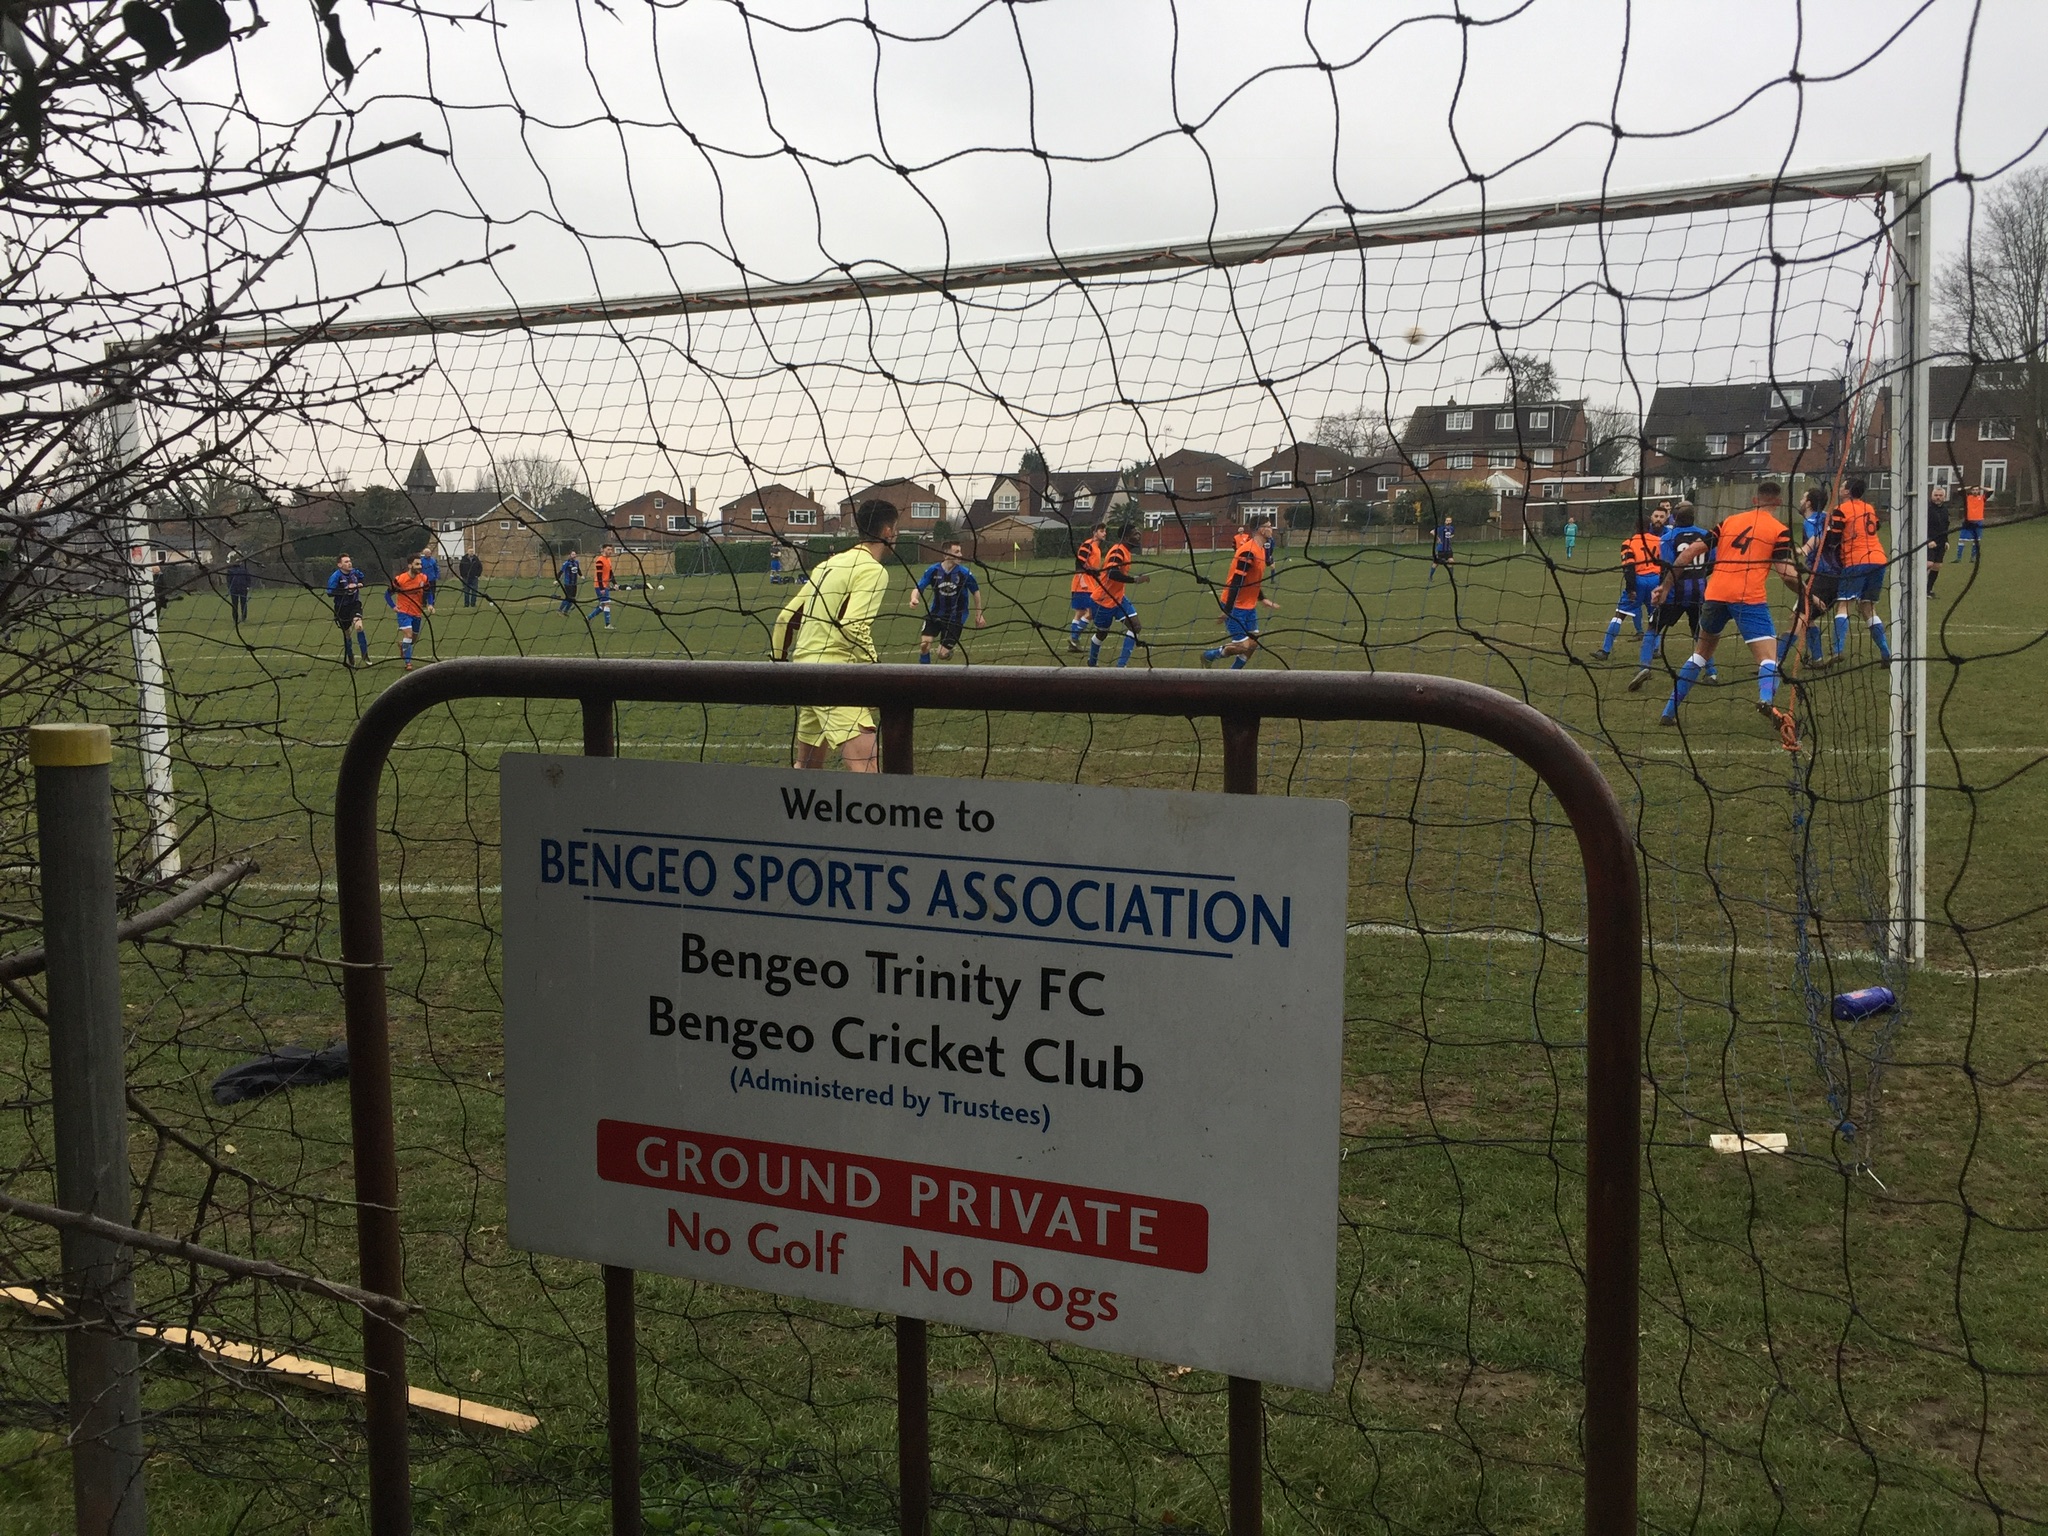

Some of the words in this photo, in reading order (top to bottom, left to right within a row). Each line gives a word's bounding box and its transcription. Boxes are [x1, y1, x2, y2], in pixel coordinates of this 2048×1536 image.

[1731, 525, 1754, 556] 4
[780, 786, 944, 830] Welcome
[955, 798, 996, 833] to
[540, 838, 717, 897] BENGEO
[732, 852, 912, 916] SPORTS
[926, 869, 1291, 949] ASSOCIATION
[681, 932, 850, 996] Bengeo
[865, 949, 1020, 1022] Trinity
[1040, 966, 1106, 1018] FC
[649, 995, 815, 1058] Bengeo
[831, 1016, 1006, 1078] Cricket
[1023, 1037, 1145, 1094] Club
[730, 1065, 895, 1108] (Administered
[902, 1085, 931, 1119] by
[937, 1090, 1052, 1134] Trustees)
[635, 1135, 881, 1209] GROUND
[911, 1174, 1159, 1255] PRIVATE
[667, 1207, 731, 1256] No
[747, 1222, 848, 1275] Golf
[902, 1245, 973, 1297] No
[992, 1259, 1119, 1332] Dogs
